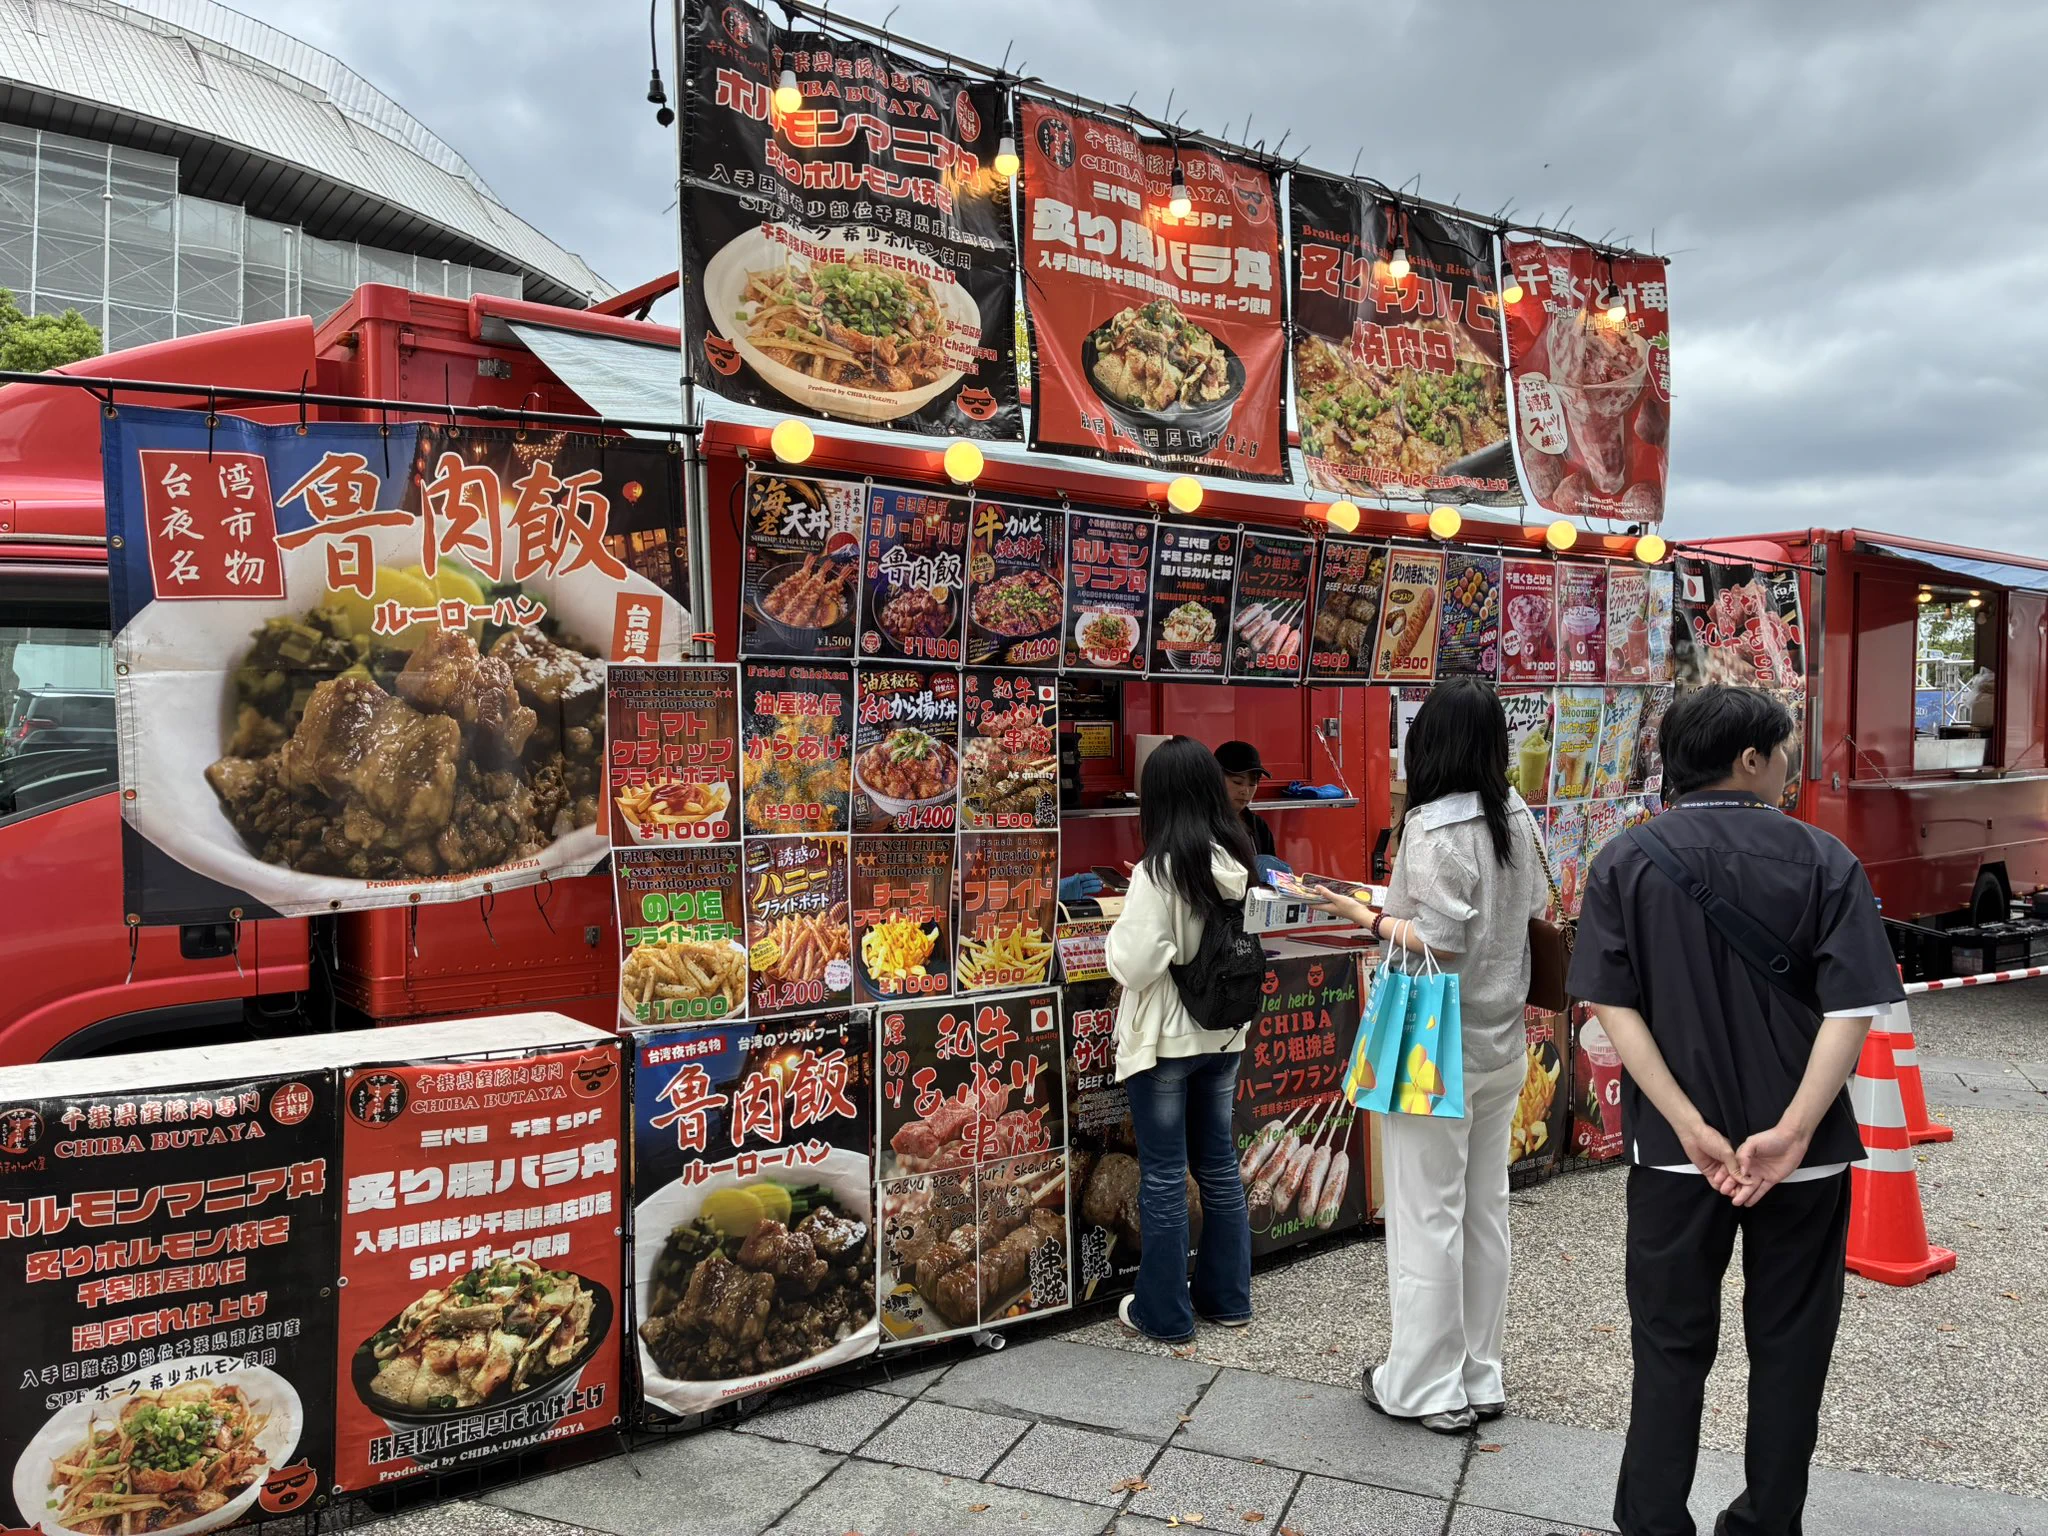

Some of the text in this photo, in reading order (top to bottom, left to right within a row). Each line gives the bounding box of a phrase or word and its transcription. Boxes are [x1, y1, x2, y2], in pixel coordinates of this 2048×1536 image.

[845, 86, 940, 121] BUTAYA
[1092, 181, 1142, 210] 三代目
[739, 196, 784, 221] SPF
[1302, 224, 1472, 277] Broiled Rice
[1181, 289, 1212, 307] SPF
[1351, 317, 1457, 378] 焼肉丼
[273, 450, 628, 599] 魯肉飯
[885, 515, 967, 546] ルーローハン
[778, 536, 810, 546] TEMPURA
[993, 533, 1046, 562] 焼肉丼
[1072, 538, 1149, 568] ホルモン
[1178, 536, 1210, 550] 三代目
[879, 545, 964, 590] 魯肉飯
[1184, 552, 1212, 564] SPF
[1072, 565, 1147, 593] マニア丼
[1325, 581, 1379, 595] BEEF DICE STEAK
[372, 597, 548, 637] ルーローハン
[817, 635, 852, 648] ¥1,500
[904, 637, 960, 660] ¥1400
[1079, 648, 1131, 663] ¥1400
[1256, 654, 1299, 670] ¥900
[1312, 652, 1350, 668] ¥900
[1394, 656, 1428, 670] ¥900
[1526, 661, 1555, 671] ¥1000
[1569, 660, 1596, 672] ¥900
[610, 669, 730, 682] FRENCH FRIES
[747, 665, 849, 681] Fried Chicken
[862, 672, 920, 694] 油屋秘伝
[993, 675, 1036, 703] 和牛
[625, 699, 716, 710] Furaidopoteto
[754, 690, 842, 717] 油屋秘伝
[859, 690, 958, 725] たれから揚げ丼
[637, 711, 708, 737] トマト
[612, 737, 733, 765] ケチャップ
[747, 733, 850, 761] からあげ
[612, 765, 736, 787] フライドポテト
[1021, 771, 1055, 780] quality
[764, 803, 822, 821] ¥900
[898, 805, 954, 830] ¥1,400
[973, 813, 1033, 828] ¥1500
[640, 820, 730, 840] ¥1000
[620, 849, 687, 864] FRENCH
[689, 847, 737, 862] FRIES
[855, 839, 950, 852] FRENCH FRIES
[983, 848, 1040, 862] Furaido
[631, 863, 726, 877] seaweed salt
[877, 852, 927, 865] CHEESE
[366, 877, 422, 890] Produced
[626, 876, 732, 891] Furaidopoteto
[858, 865, 944, 878] Furaidopoteto
[989, 864, 1034, 879] poteto
[752, 868, 831, 905] ハニー
[873, 882, 930, 906] チーズ
[964, 878, 1053, 912] フライド
[642, 890, 725, 923] のり塩
[757, 892, 831, 920] フライドポテト
[853, 905, 947, 928] フライドポテト
[623, 923, 743, 947] フライドポテト
[975, 910, 1039, 942] ポテト
[879, 973, 948, 994] ¥1000
[972, 968, 1026, 986] ¥900
[635, 996, 728, 1020] ¥1000
[756, 980, 825, 1011] ¥1,200
[1287, 984, 1355, 1009] herb frank
[935, 1006, 1020, 1060] 和牛
[1259, 1009, 1333, 1037] CHIBA
[647, 1022, 849, 1065] 台湾夜市名物 台湾のソウルフード
[1254, 1032, 1337, 1069] 炙り粗挽き
[1077, 1074, 1104, 1091] BEEF
[410, 1094, 480, 1115] CHIBA
[483, 1085, 567, 1111] BUTAYA
[650, 1049, 857, 1152] 魯肉飯
[54, 1120, 266, 1159] CHIBA BUTAYA
[420, 1108, 603, 1149] 三代目 千葉 SPF
[1292, 1121, 1318, 1138] herb
[681, 1138, 831, 1189] ルーローハン
[346, 1138, 618, 1215] 炙り豚バラ丼
[0, 1158, 327, 1240] ホルモンマニア丼
[26, 1215, 291, 1284] 炙りホルモン焼き
[409, 1232, 571, 1281] SPF ポーク使用
[77, 1256, 247, 1309] 千葉豚屋秘伝
[45, 1348, 277, 1411] SPF 希少ホルモン使用
[722, 1383, 756, 1397] Produced
[758, 1378, 768, 1388] By
[379, 1422, 585, 1482] Produced by CHIBA-UMAKAPPEYA
